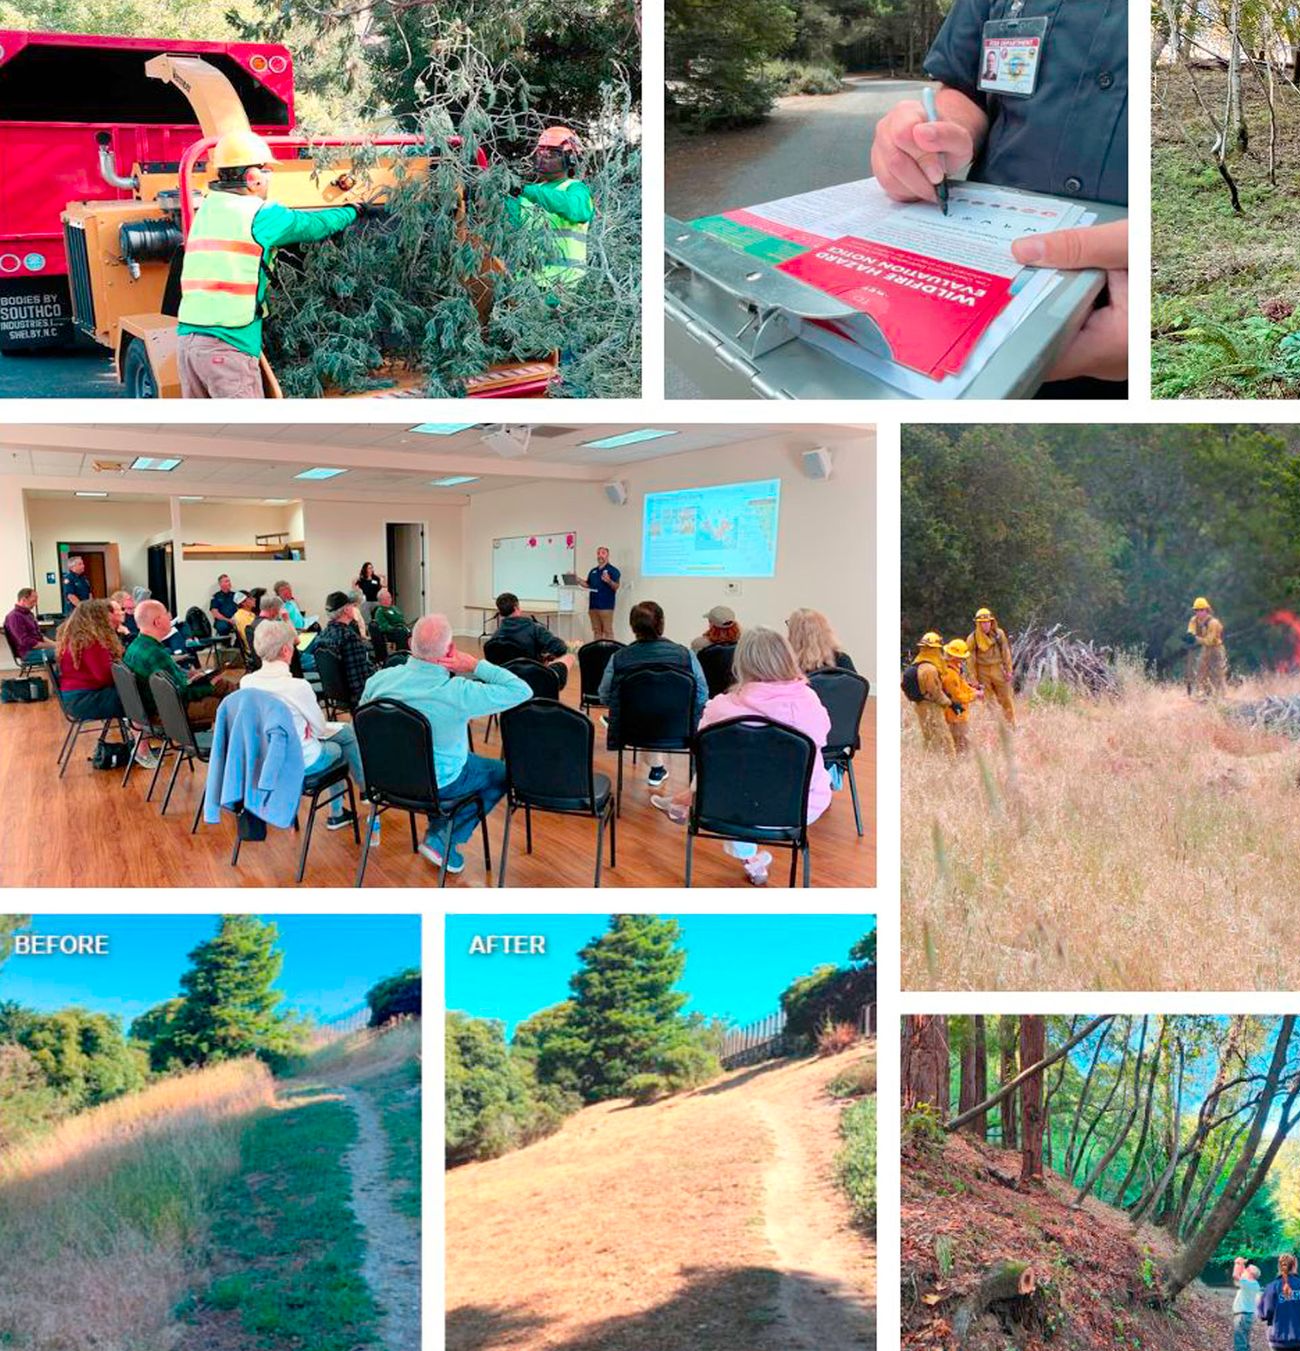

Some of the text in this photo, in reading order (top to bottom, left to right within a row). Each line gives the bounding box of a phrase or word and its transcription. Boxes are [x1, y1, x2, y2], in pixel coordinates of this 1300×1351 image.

[816, 252, 882, 277] HAZARD
[879, 260, 988, 298] EVALUATION
[883, 273, 976, 307] WILDFIRE
[1, 294, 57, 306] BODIES BY
[1, 304, 61, 320] SOUTHCO
